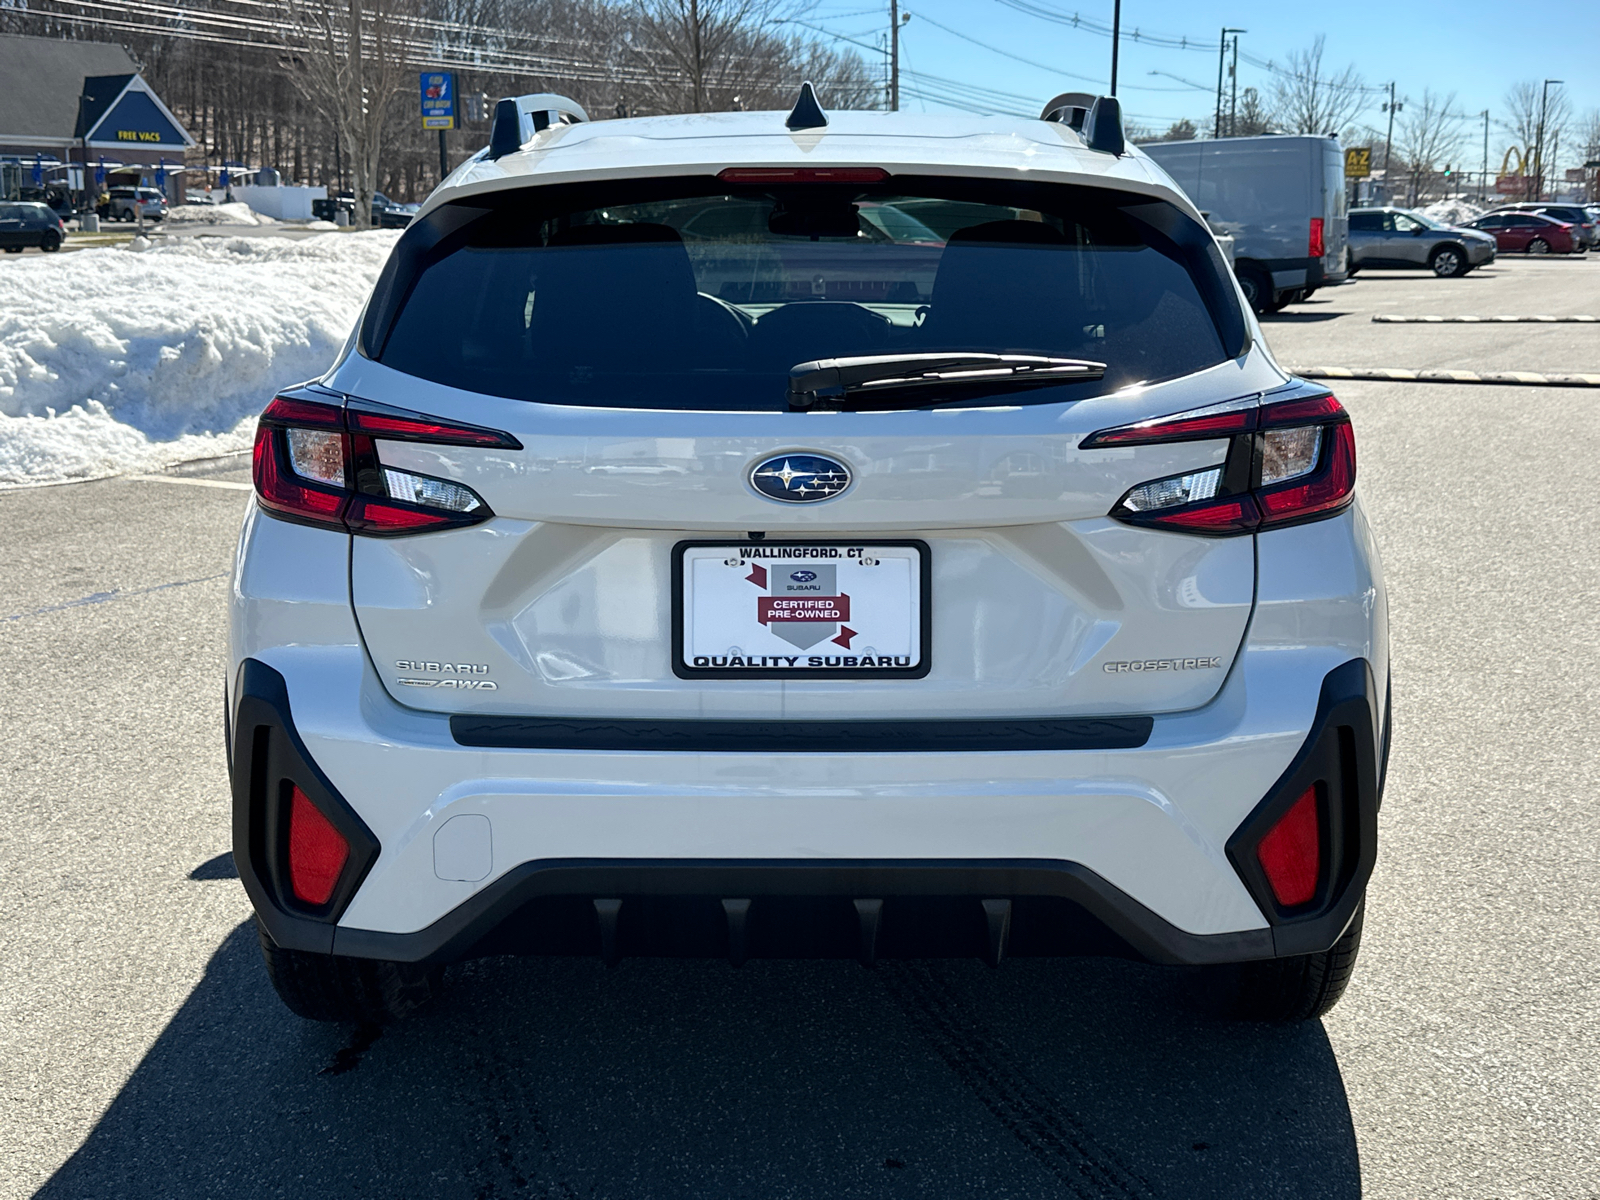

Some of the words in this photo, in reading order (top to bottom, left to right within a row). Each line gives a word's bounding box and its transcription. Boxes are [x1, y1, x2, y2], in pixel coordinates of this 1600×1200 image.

[118, 130, 137, 140] FREE
[138, 131, 161, 142] VACS
[739, 547, 843, 559] WALLINGFORD,
[846, 547, 865, 559] CT
[773, 600, 834, 610] CERTIFIED
[767, 609, 841, 619] PRE-OWNED
[395, 659, 490, 676] SUBARU
[693, 655, 799, 668] QUALITY
[807, 656, 911, 668] SUBARU
[1103, 656, 1223, 674] CROSSTREK
[433, 679, 499, 692] AWD
